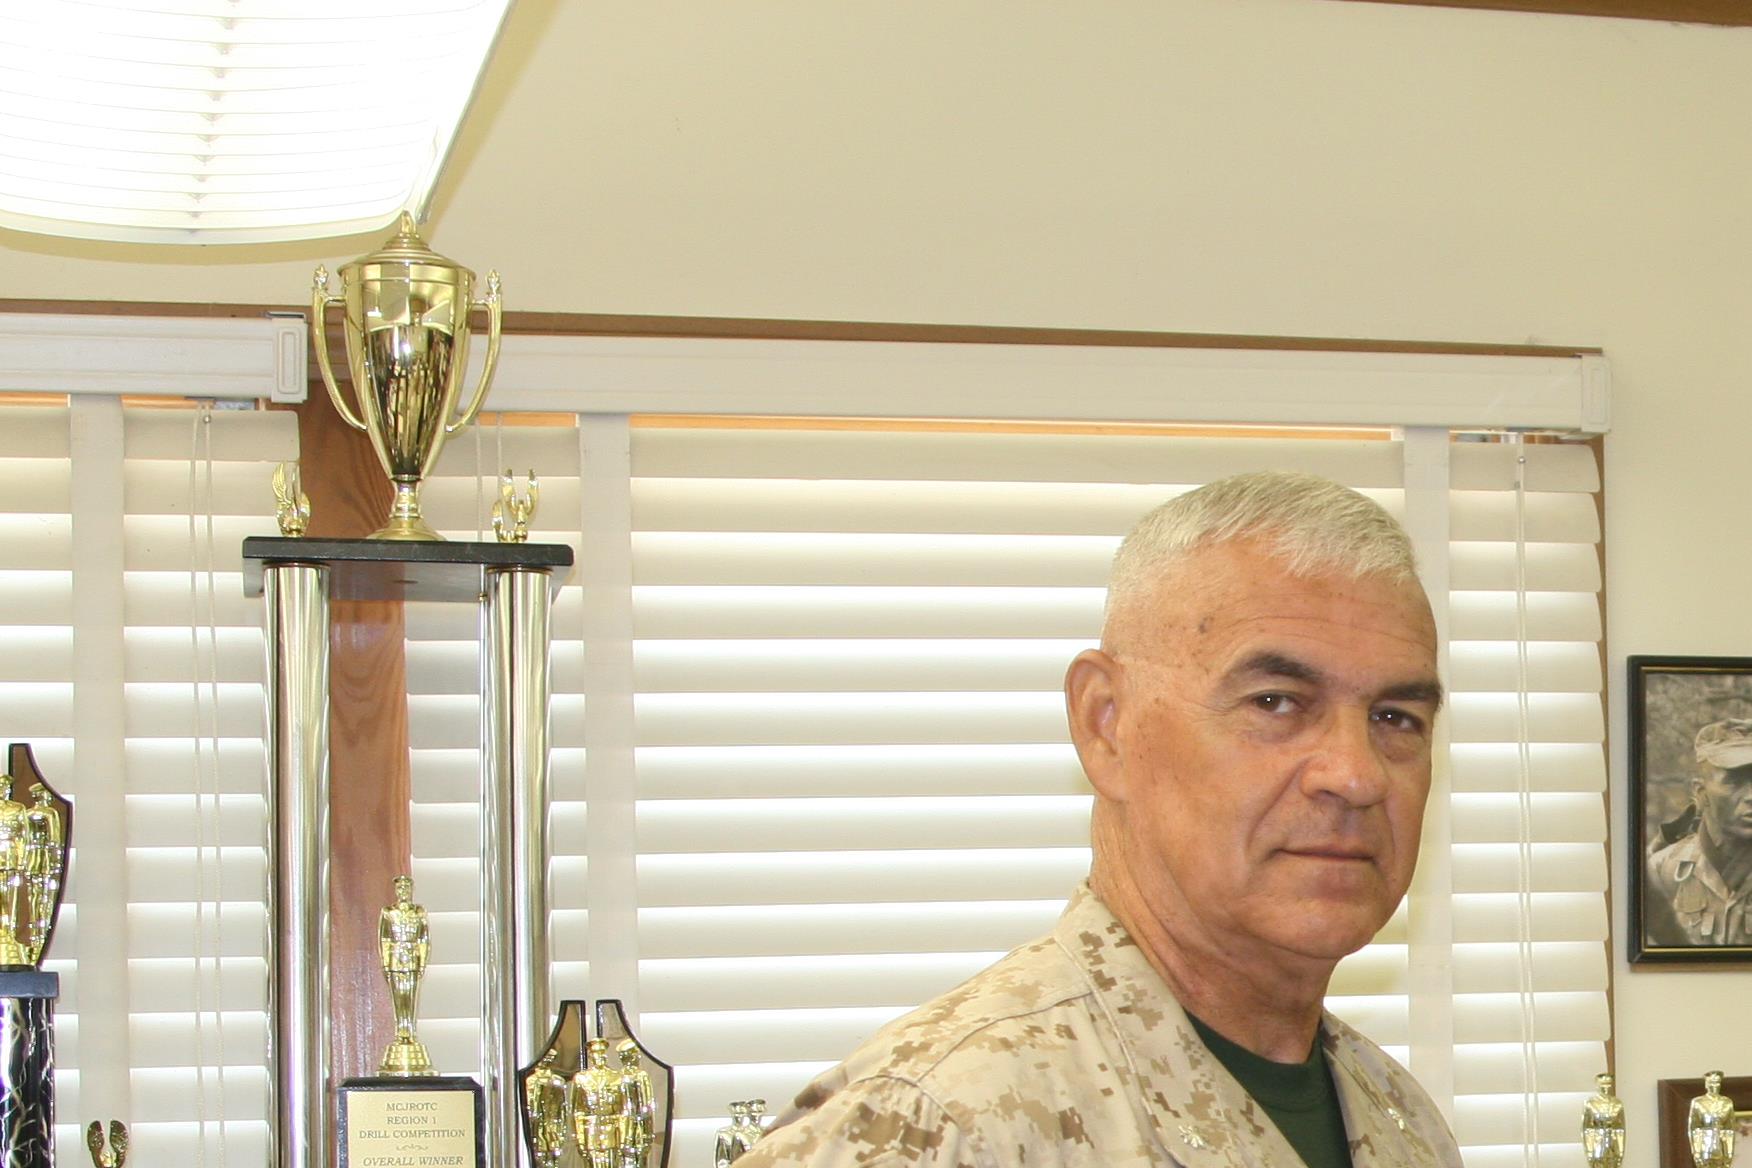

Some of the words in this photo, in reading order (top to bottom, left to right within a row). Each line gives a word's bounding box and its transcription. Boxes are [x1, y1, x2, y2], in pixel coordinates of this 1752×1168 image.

[386, 1102, 438, 1112] MCJROTC
[387, 1116, 428, 1125] REGION
[432, 1116, 437, 1125] 1
[359, 1130, 390, 1139] DRILL
[393, 1129, 466, 1139] COMPETITION
[363, 1157, 415, 1167] OVERALL
[418, 1156, 464, 1166] WINNER
